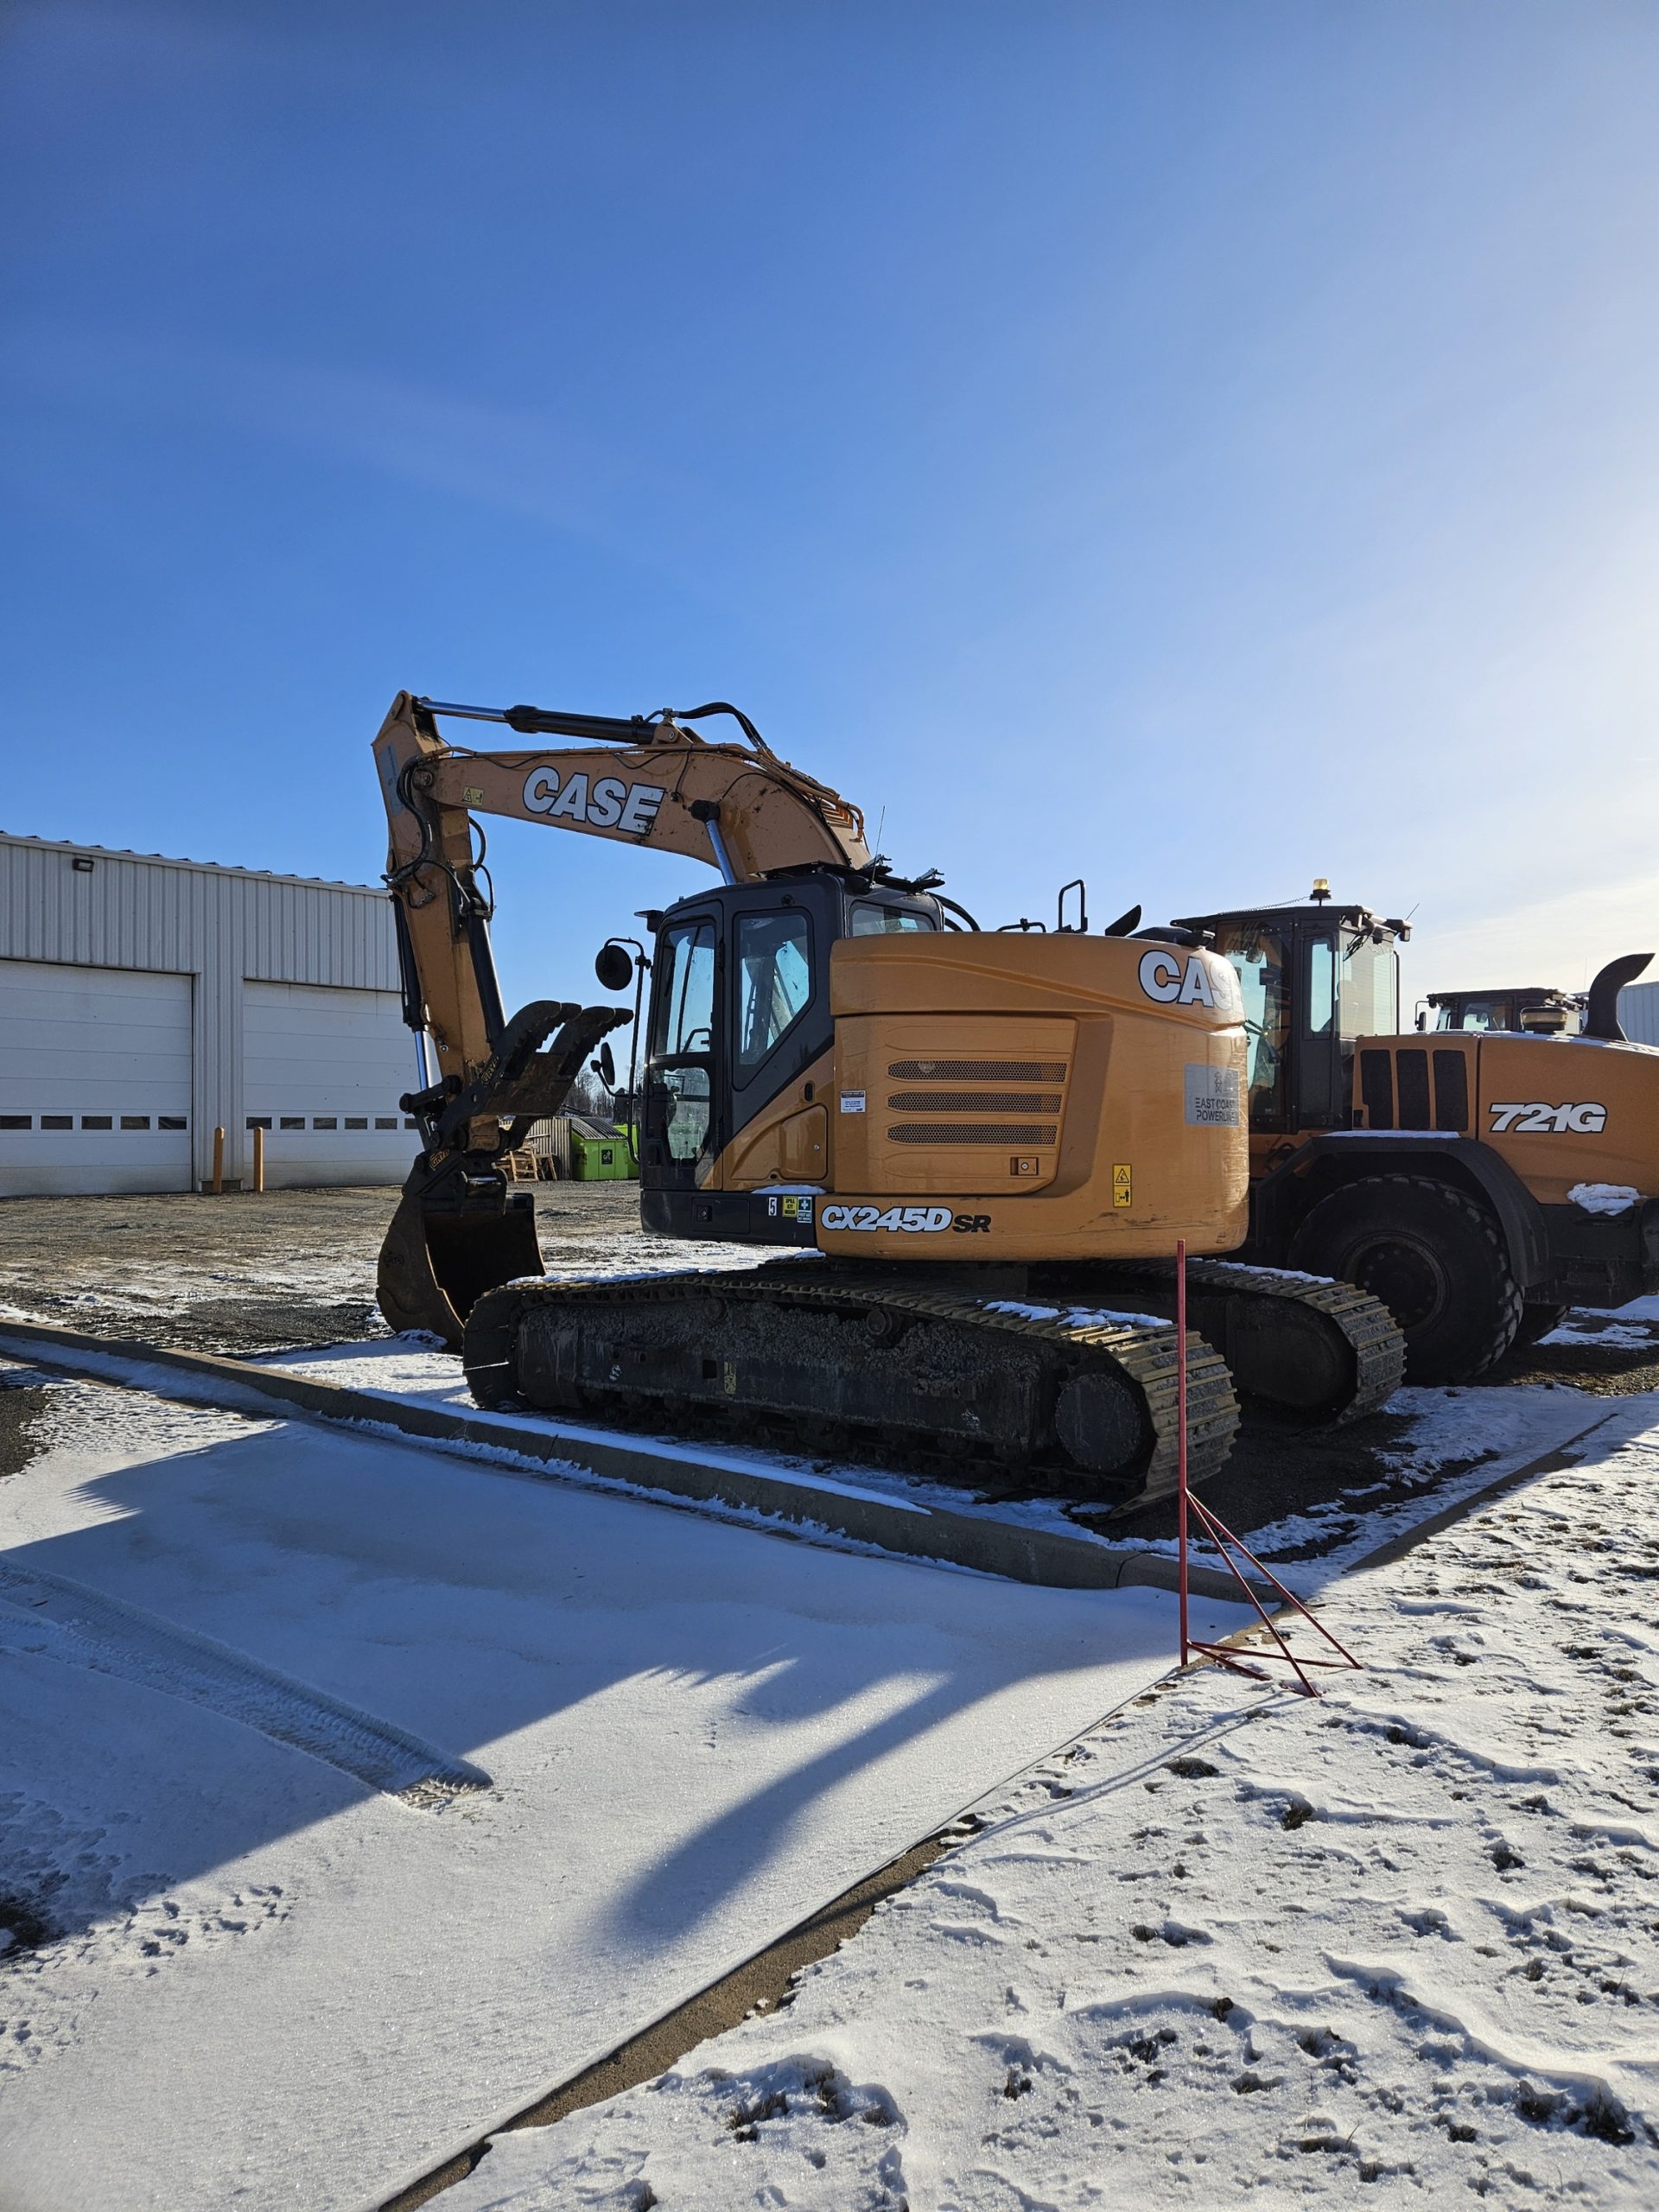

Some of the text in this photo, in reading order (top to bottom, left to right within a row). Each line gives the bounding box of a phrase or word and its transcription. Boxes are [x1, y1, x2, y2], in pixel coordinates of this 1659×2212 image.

[523, 765, 666, 836] CASE
[1195, 1096, 1215, 1109] EAST
[1489, 1102, 1607, 1134] 721G
[770, 1198, 775, 1215] 5
[821, 1204, 992, 1233] CX245D SR
